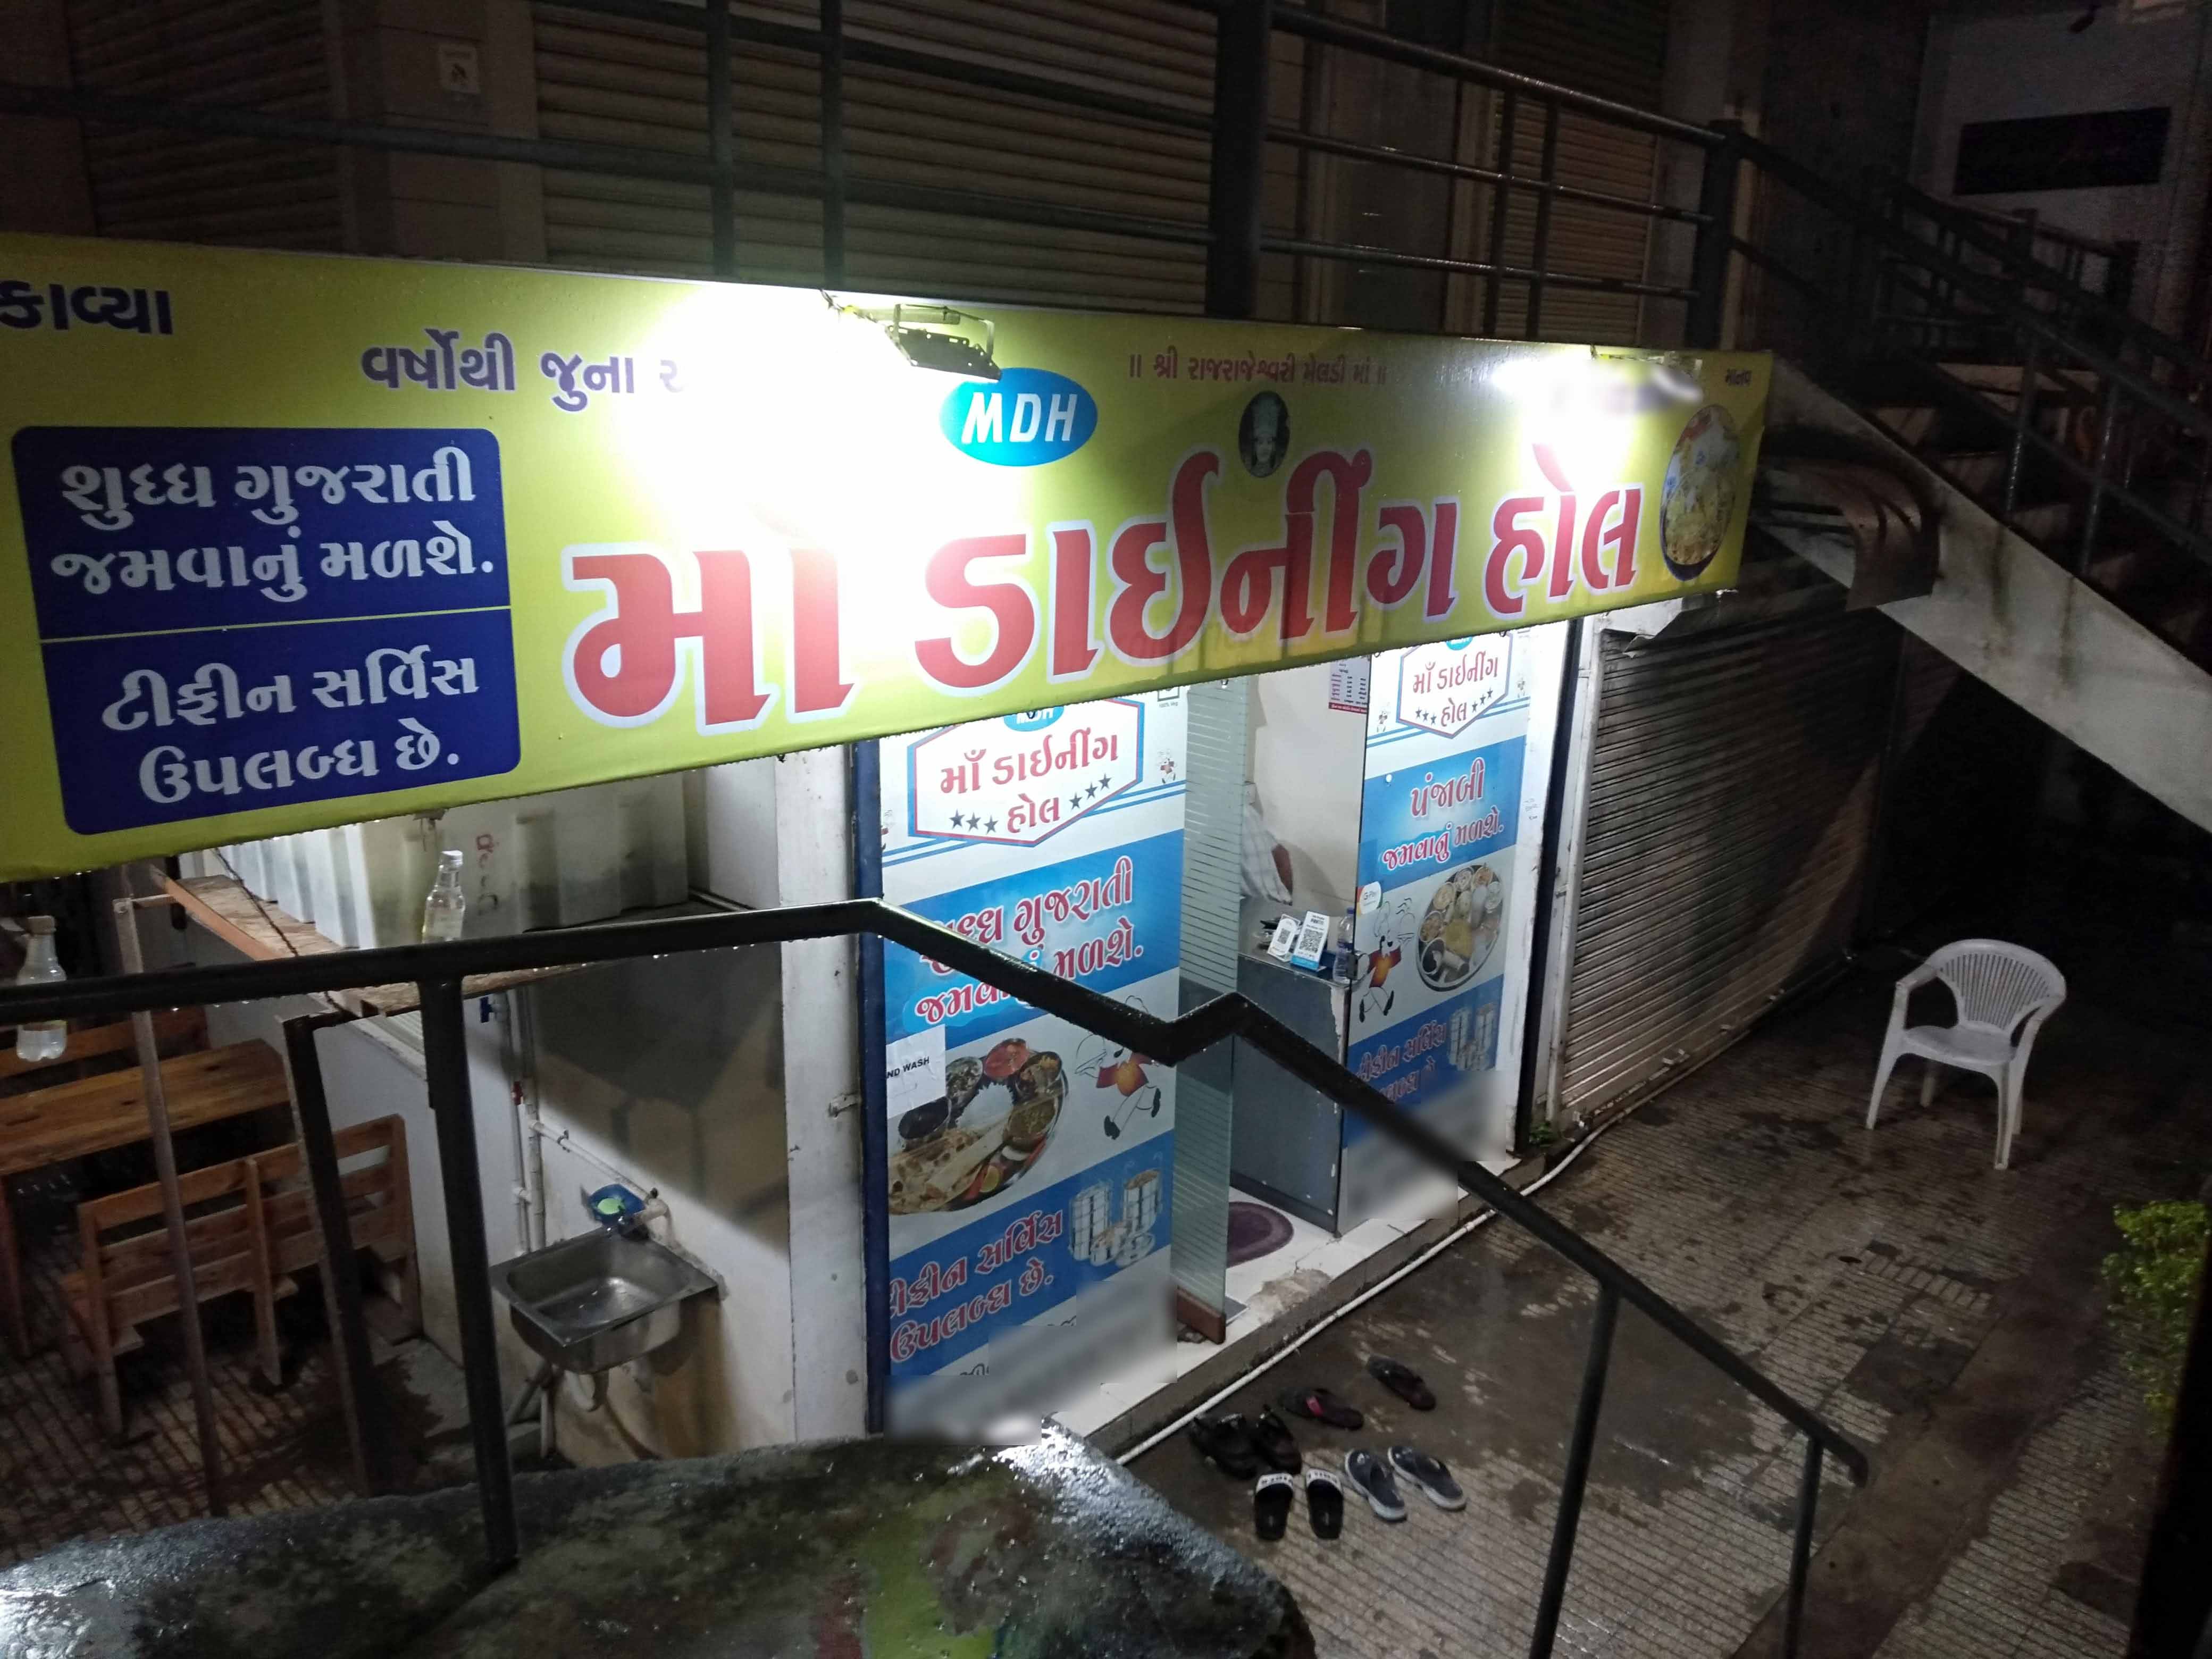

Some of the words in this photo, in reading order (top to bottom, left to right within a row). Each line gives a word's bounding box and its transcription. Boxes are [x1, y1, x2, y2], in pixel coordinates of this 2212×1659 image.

[961, 392, 1077, 444] MDH
[234, 447, 476, 526] ગુજરાતી
[1485, 442, 1642, 615] હોલ
[51, 526, 308, 603] જમવાનું
[320, 520, 494, 581] મળશે.
[102, 663, 297, 731] ટીફીન
[312, 645, 480, 709] સર્વિસ
[1440, 697, 1467, 727] હોલ
[395, 718, 459, 771] છે.
[1006, 793, 1060, 833] હોલ
[1411, 757, 1486, 818] પંજાબી
[1013, 856, 1133, 945] ગુજરાતી
[902, 1055, 930, 1073] WASH
